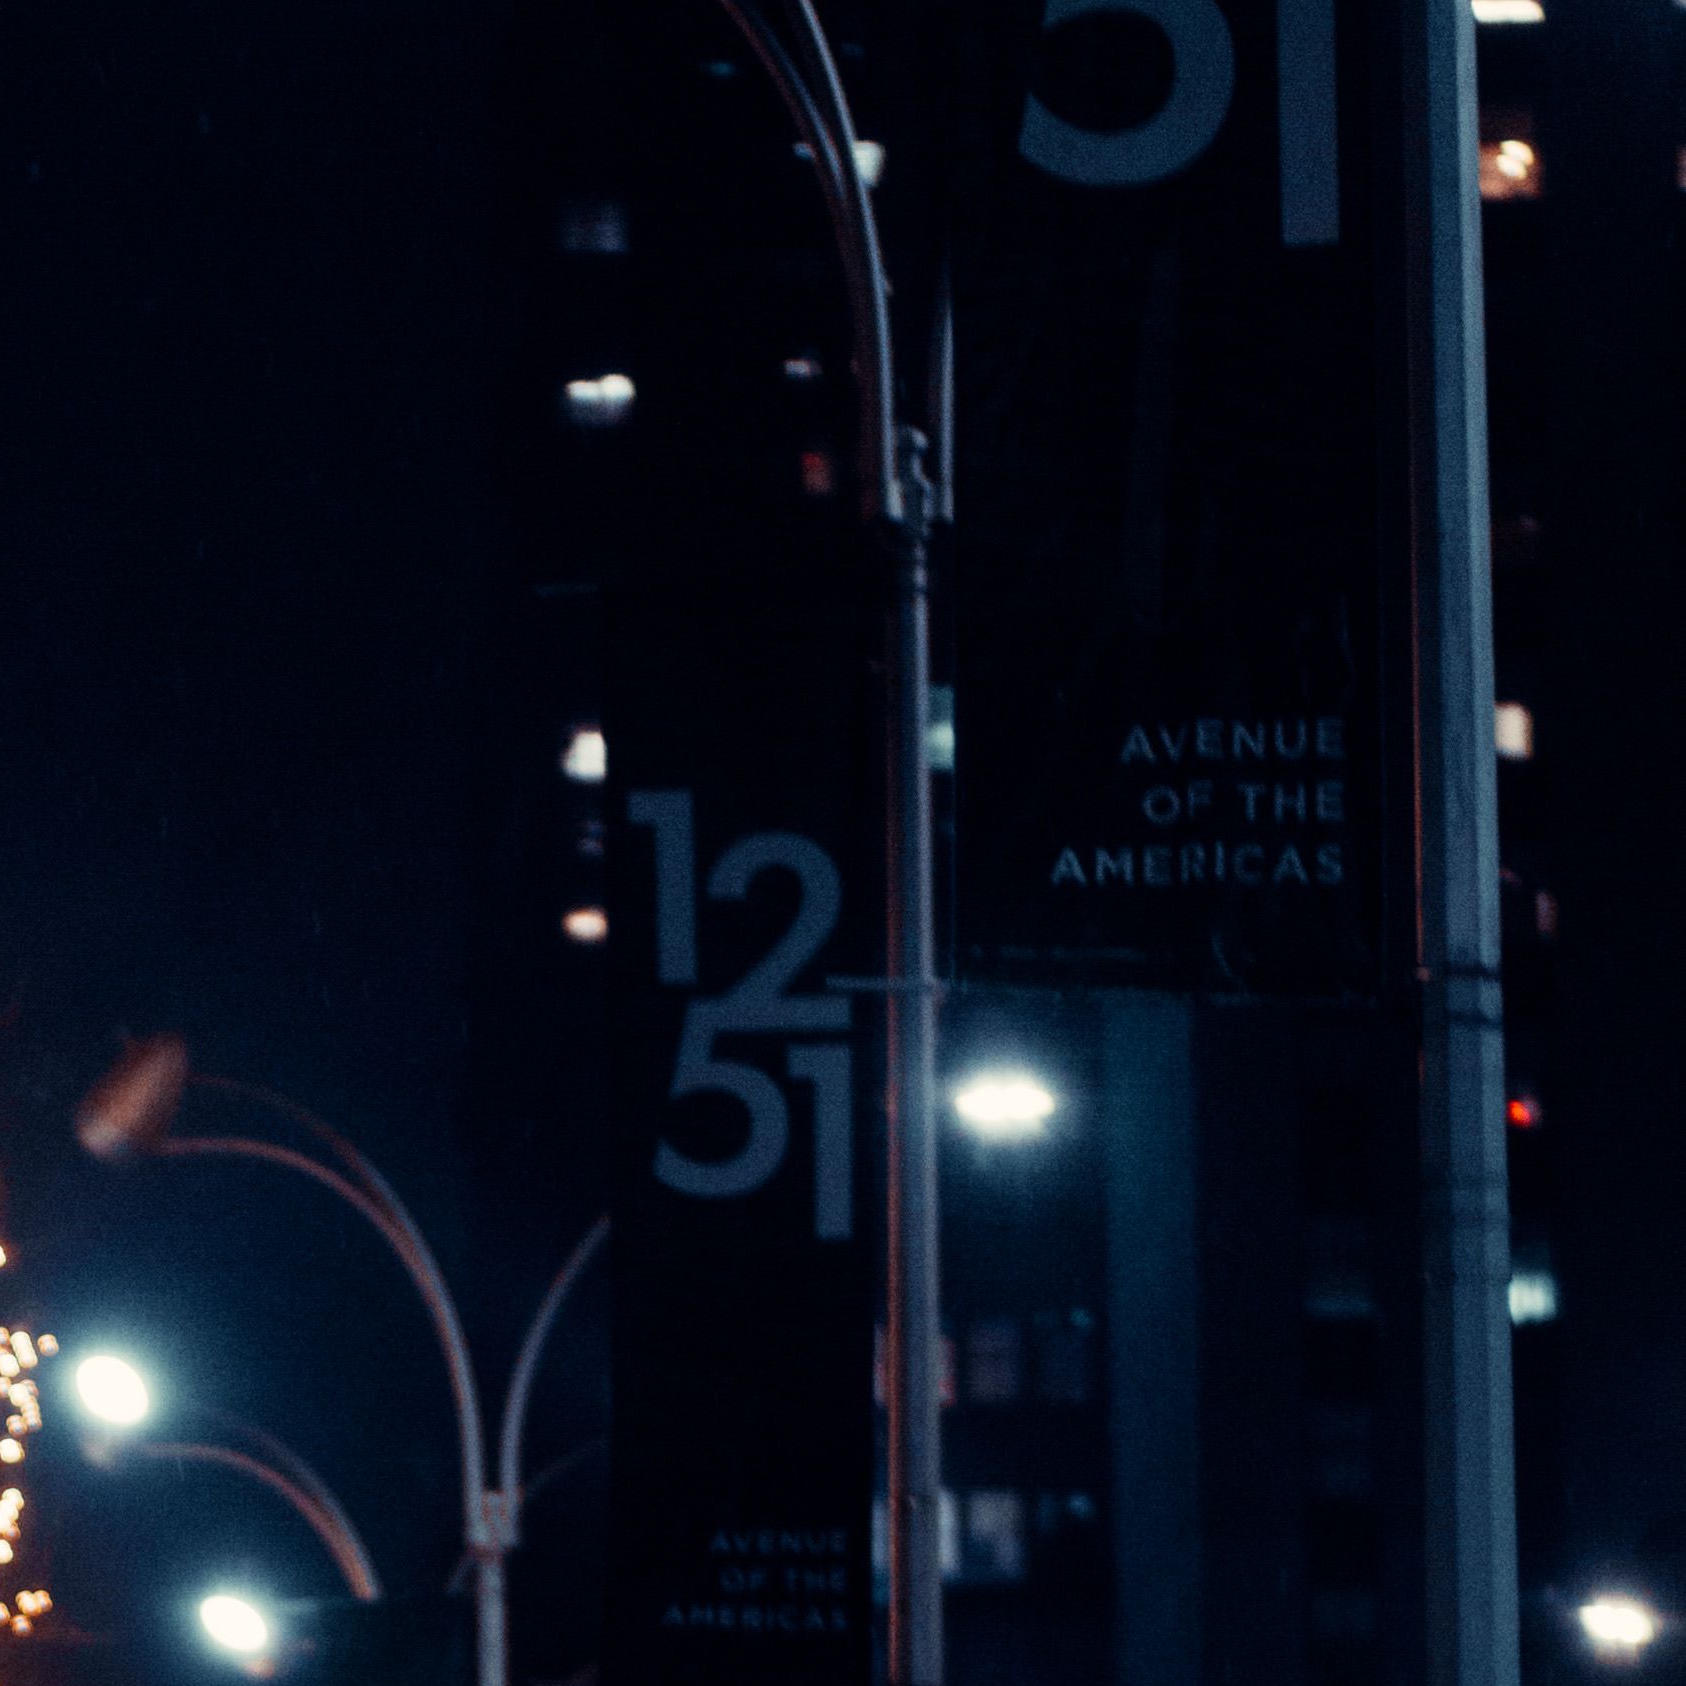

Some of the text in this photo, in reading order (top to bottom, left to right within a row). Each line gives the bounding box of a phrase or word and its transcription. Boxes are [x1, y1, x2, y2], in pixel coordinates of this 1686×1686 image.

[1118, 715, 1346, 765] AVENUE
[1142, 777, 1346, 826] OF THE
[1050, 841, 1346, 888] AMERICAS
[709, 1526, 848, 1555] AVENUE
[718, 1564, 848, 1595] OF THE
[661, 1602, 848, 1632] AMERICAS
